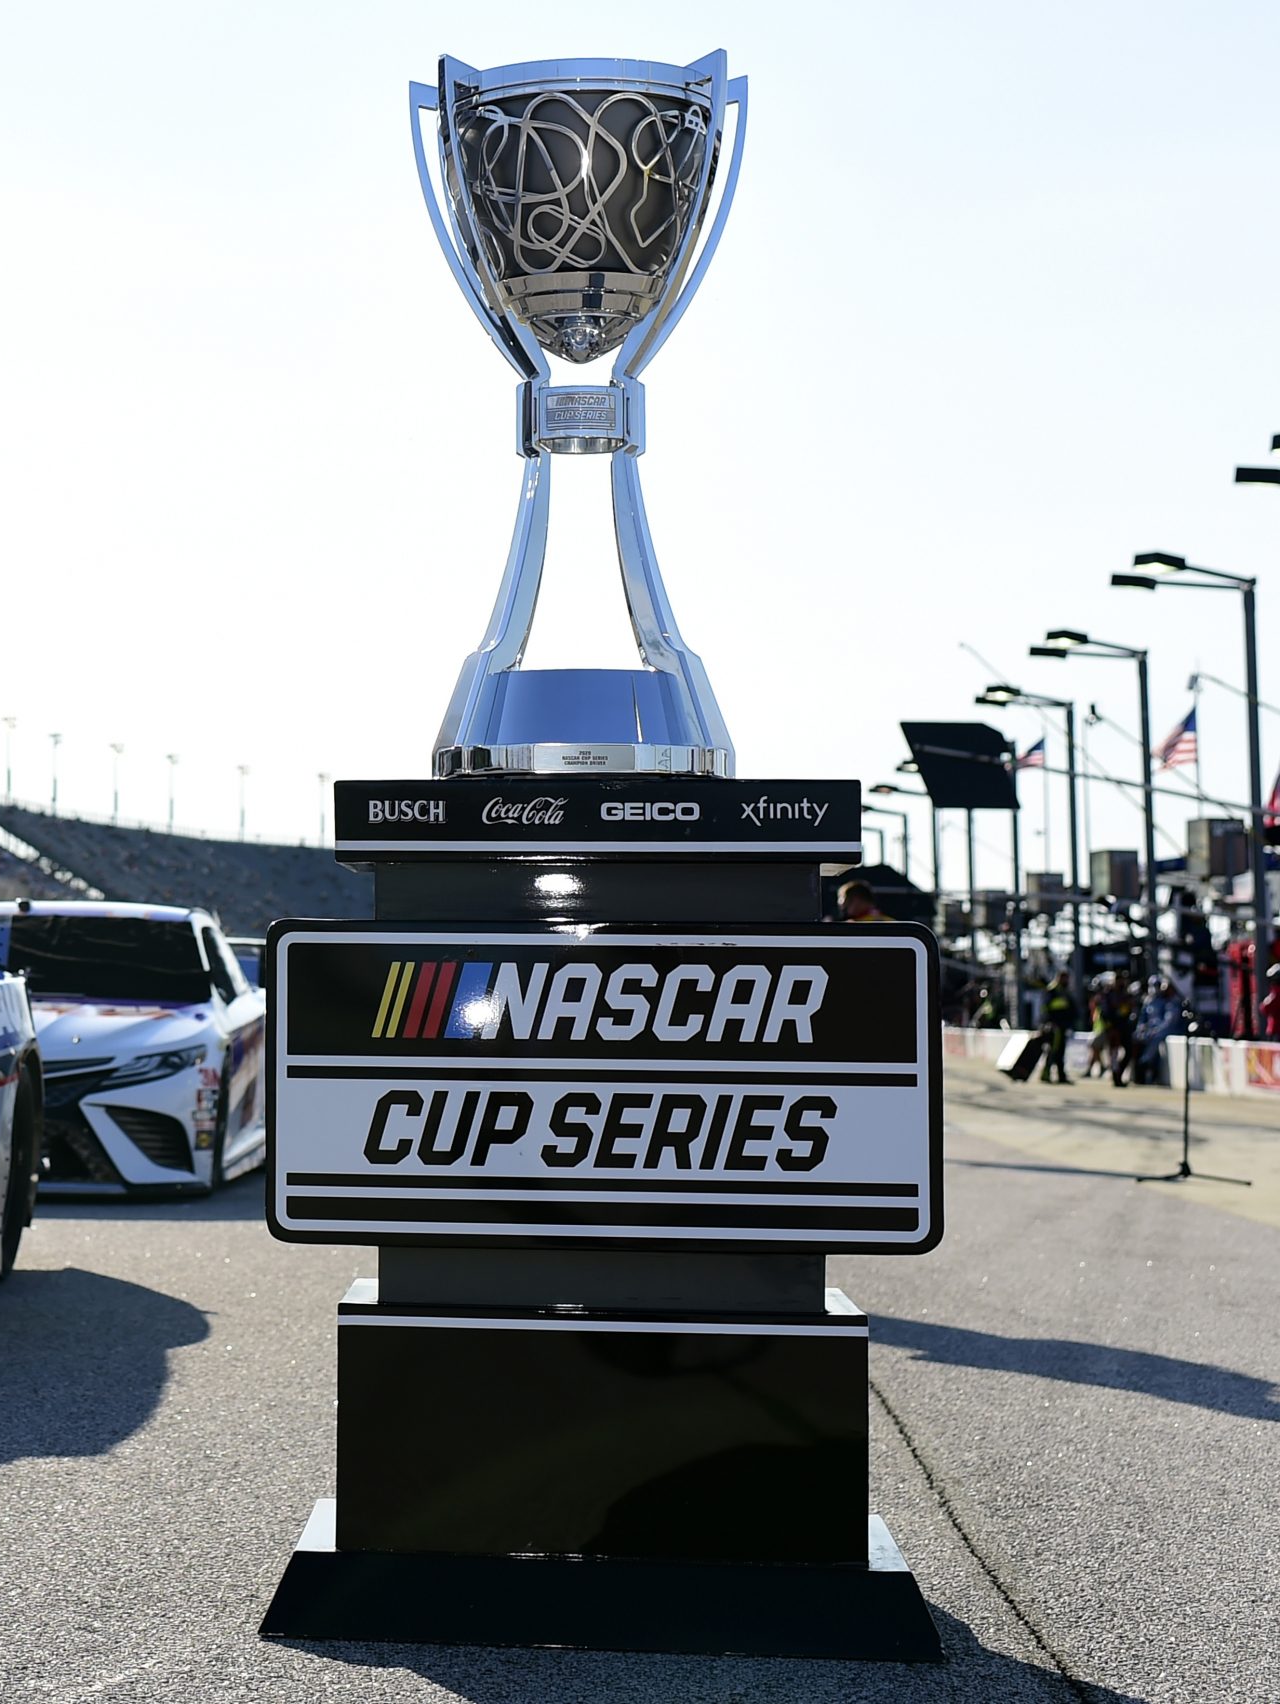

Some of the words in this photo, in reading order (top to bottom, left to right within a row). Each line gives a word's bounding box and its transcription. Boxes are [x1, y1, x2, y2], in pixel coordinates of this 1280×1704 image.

[368, 799, 447, 824] BUSCH
[600, 802, 701, 821] GEICO
[740, 795, 829, 827] xfinity
[480, 961, 829, 1044] NASCAR
[362, 1089, 535, 1167] CUP
[540, 1091, 838, 1172] SERIES
